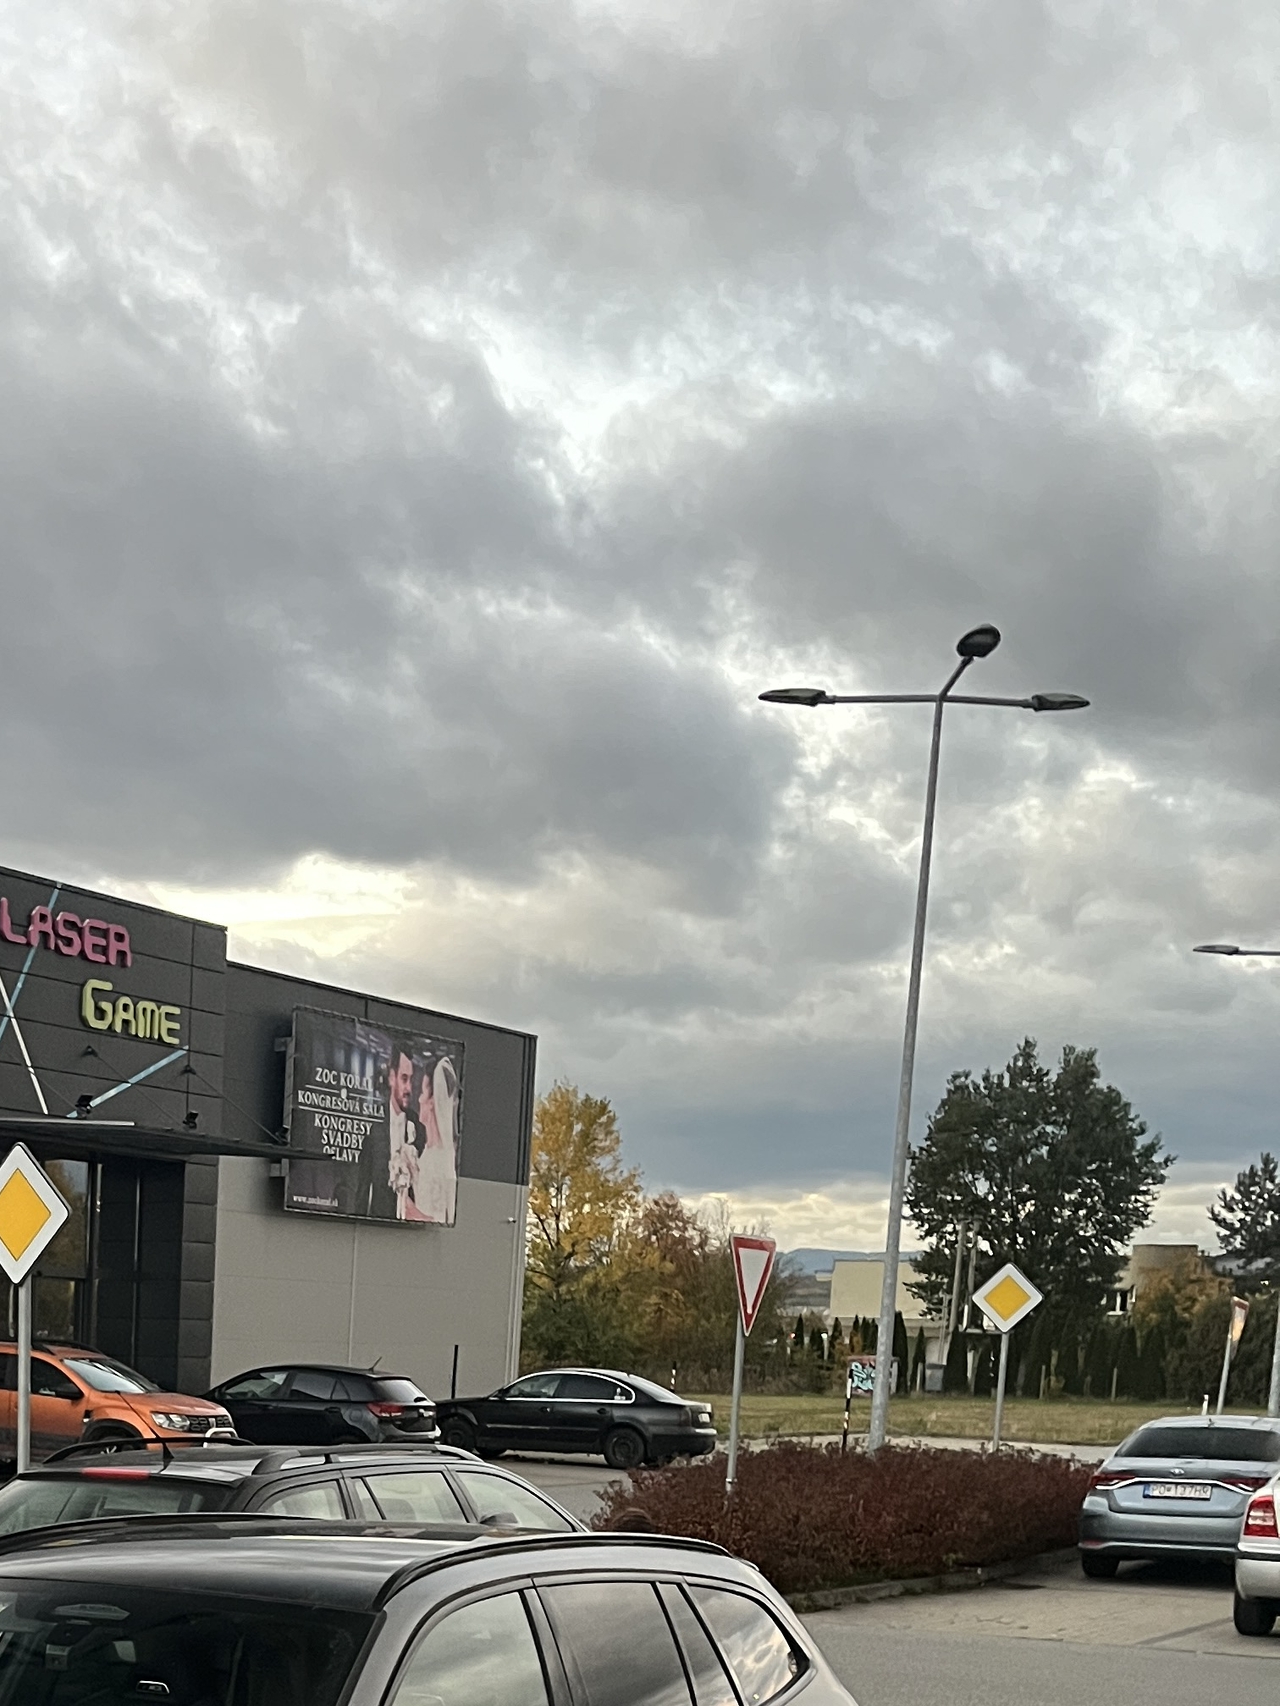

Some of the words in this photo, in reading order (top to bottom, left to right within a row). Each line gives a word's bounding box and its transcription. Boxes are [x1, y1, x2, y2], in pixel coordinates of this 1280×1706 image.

[82, 978, 181, 1045] GAME
[315, 1067, 338, 1085] ZOC
[314, 1113, 373, 1136] KONGRESY
[321, 1129, 366, 1150] SVADBY
